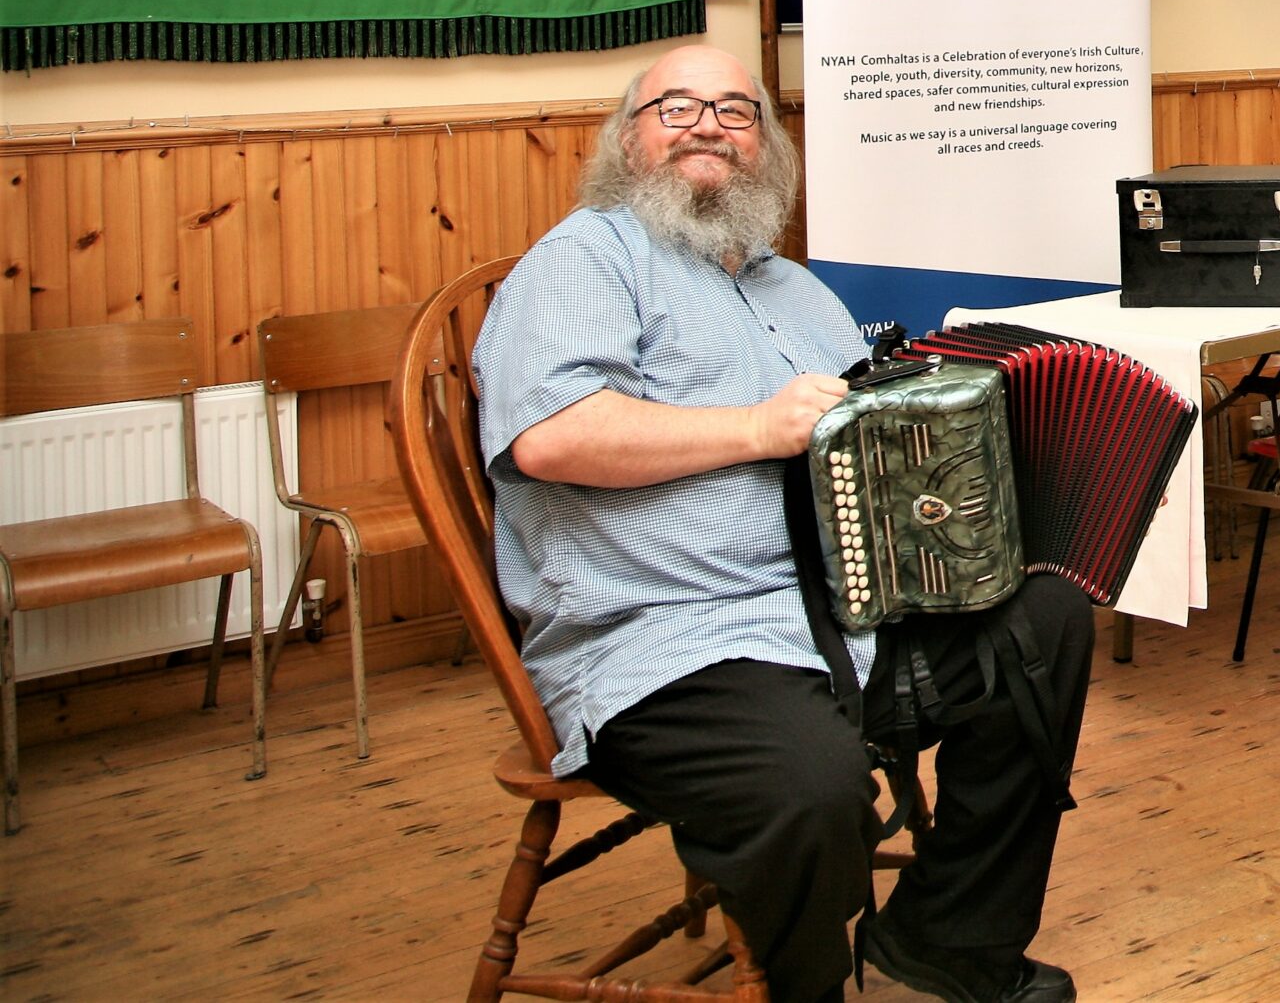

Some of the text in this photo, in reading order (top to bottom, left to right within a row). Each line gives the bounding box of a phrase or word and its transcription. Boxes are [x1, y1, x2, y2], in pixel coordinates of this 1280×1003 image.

[822, 56, 855, 66] NYAH
[861, 54, 919, 65] Comhaltas
[923, 53, 930, 63] is
[943, 50, 1006, 62] Celebration
[1009, 49, 1020, 59] of
[1080, 46, 1101, 56] Irish
[1105, 46, 1143, 55] Culture,
[851, 71, 893, 85] people,
[896, 69, 930, 83] youth,
[933, 68, 983, 80] diversity,
[986, 65, 1047, 76] community,
[1076, 63, 1122, 72] horizons,
[844, 78, 1129, 100] shared spaces, safer communities, cultural expression
[934, 101, 955, 112] and
[985, 97, 1045, 109] friendships.
[861, 132, 892, 143] Music
[896, 133, 907, 141] as
[910, 132, 925, 140] we
[928, 131, 946, 141] say
[949, 128, 957, 137] is
[969, 124, 1018, 136] universal
[1021, 123, 1068, 135] language
[1071, 119, 1117, 130] covering
[938, 138, 1043, 154] all races and creeds.
